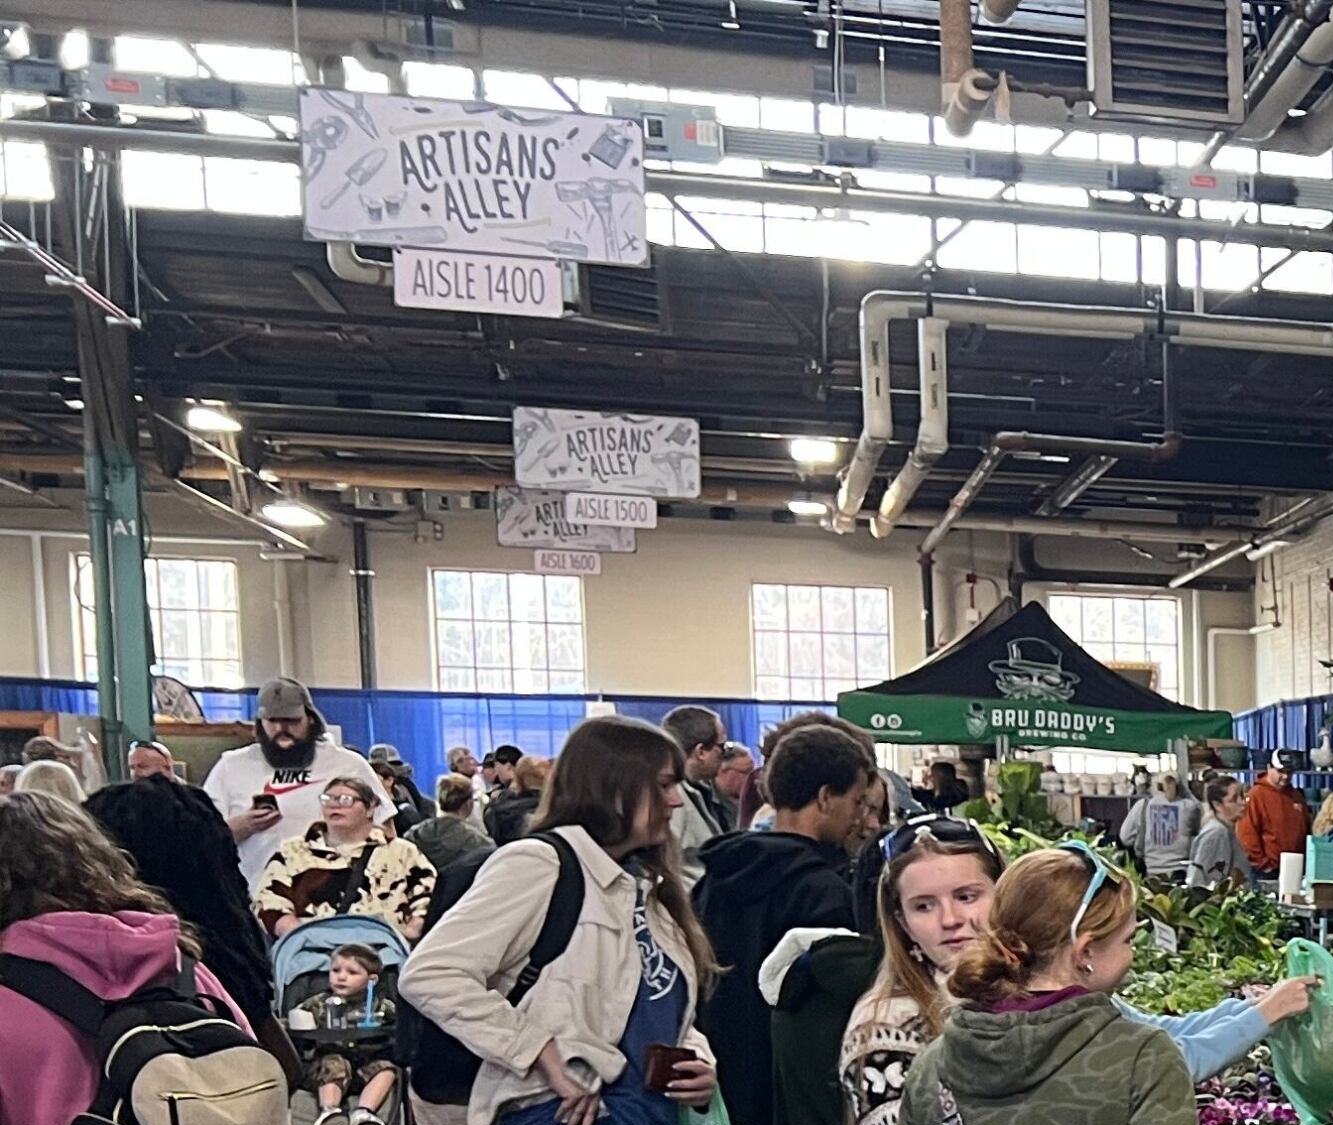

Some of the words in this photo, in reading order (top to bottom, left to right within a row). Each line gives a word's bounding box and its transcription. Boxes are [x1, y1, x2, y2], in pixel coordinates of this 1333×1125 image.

[444, 178, 531, 233] ALLEY
[412, 259, 476, 300] AISLE
[484, 264, 545, 305] 1400
[590, 453, 638, 483] ALLEY
[535, 501, 566, 526] ARTI
[575, 498, 611, 521] AISLE
[615, 500, 648, 522] 1500
[113, 519, 137, 536] A1
[541, 552, 566, 569] AISLE
[569, 554, 595, 571] 1600
[992, 709, 1028, 728] BRU
[1035, 710, 1115, 734] DADDY'S
[272, 770, 311, 784] NIKE
